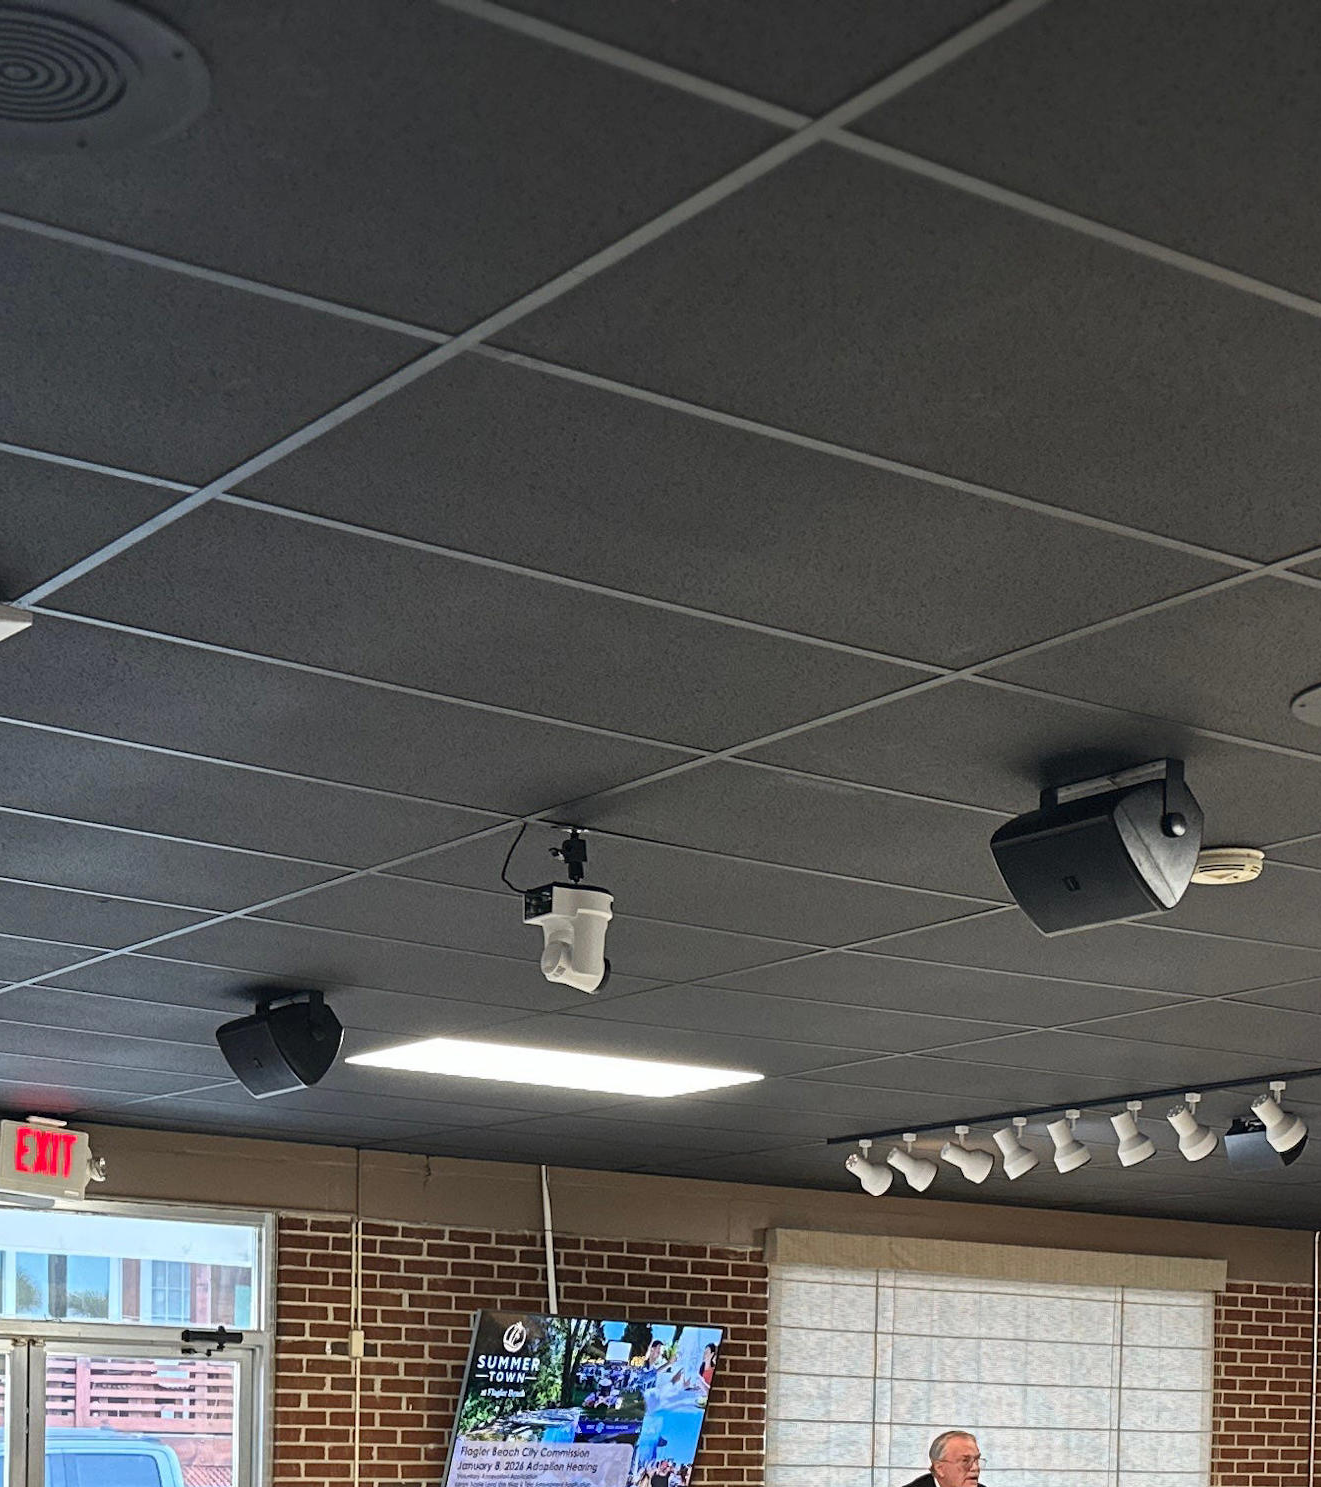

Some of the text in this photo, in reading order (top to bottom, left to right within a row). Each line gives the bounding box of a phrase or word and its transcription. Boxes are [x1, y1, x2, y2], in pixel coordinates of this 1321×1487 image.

[15, 1126, 78, 1178] EXIT
[477, 1355, 540, 1371] SUMMER
[488, 1371, 526, 1383] TOWN
[460, 1446, 590, 1459] Flagler Beach City Commission
[457, 1461, 493, 1472] January
[566, 1463, 599, 1473] Hearing
